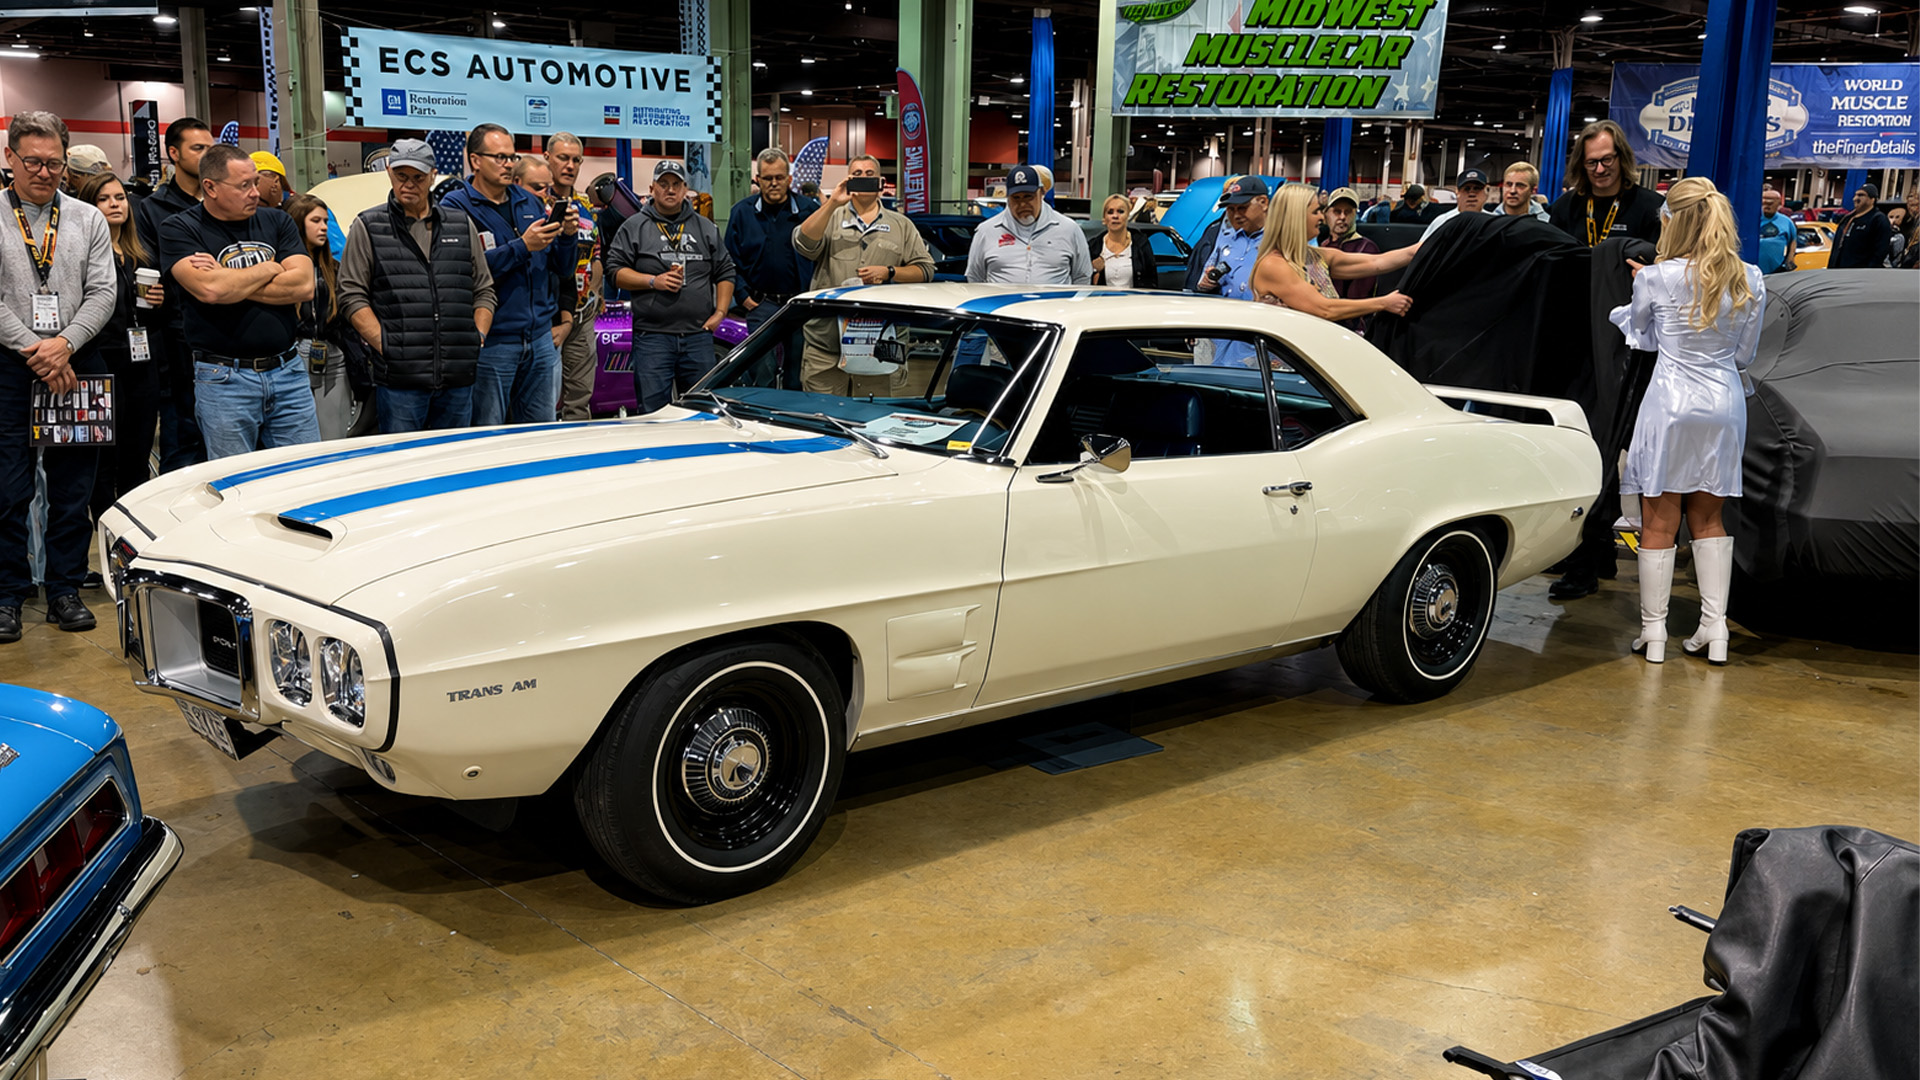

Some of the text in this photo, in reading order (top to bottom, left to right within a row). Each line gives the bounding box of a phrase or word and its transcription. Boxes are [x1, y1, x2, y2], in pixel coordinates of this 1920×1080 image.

[1245, 0, 1439, 30] MIDWEST
[1182, 33, 1415, 69] MUSCLECAR
[379, 47, 691, 93] ECS AUTOMOTIVE
[1121, 73, 1392, 109] RESTORATION
[1844, 79, 1904, 91] WORLD
[409, 93, 467, 107] Restoration
[410, 105, 437, 116] Parts
[1831, 95, 1909, 111] MUSCLE
[1811, 138, 1917, 155] theFinerDetails
[446, 678, 537, 703] TRANS AM
